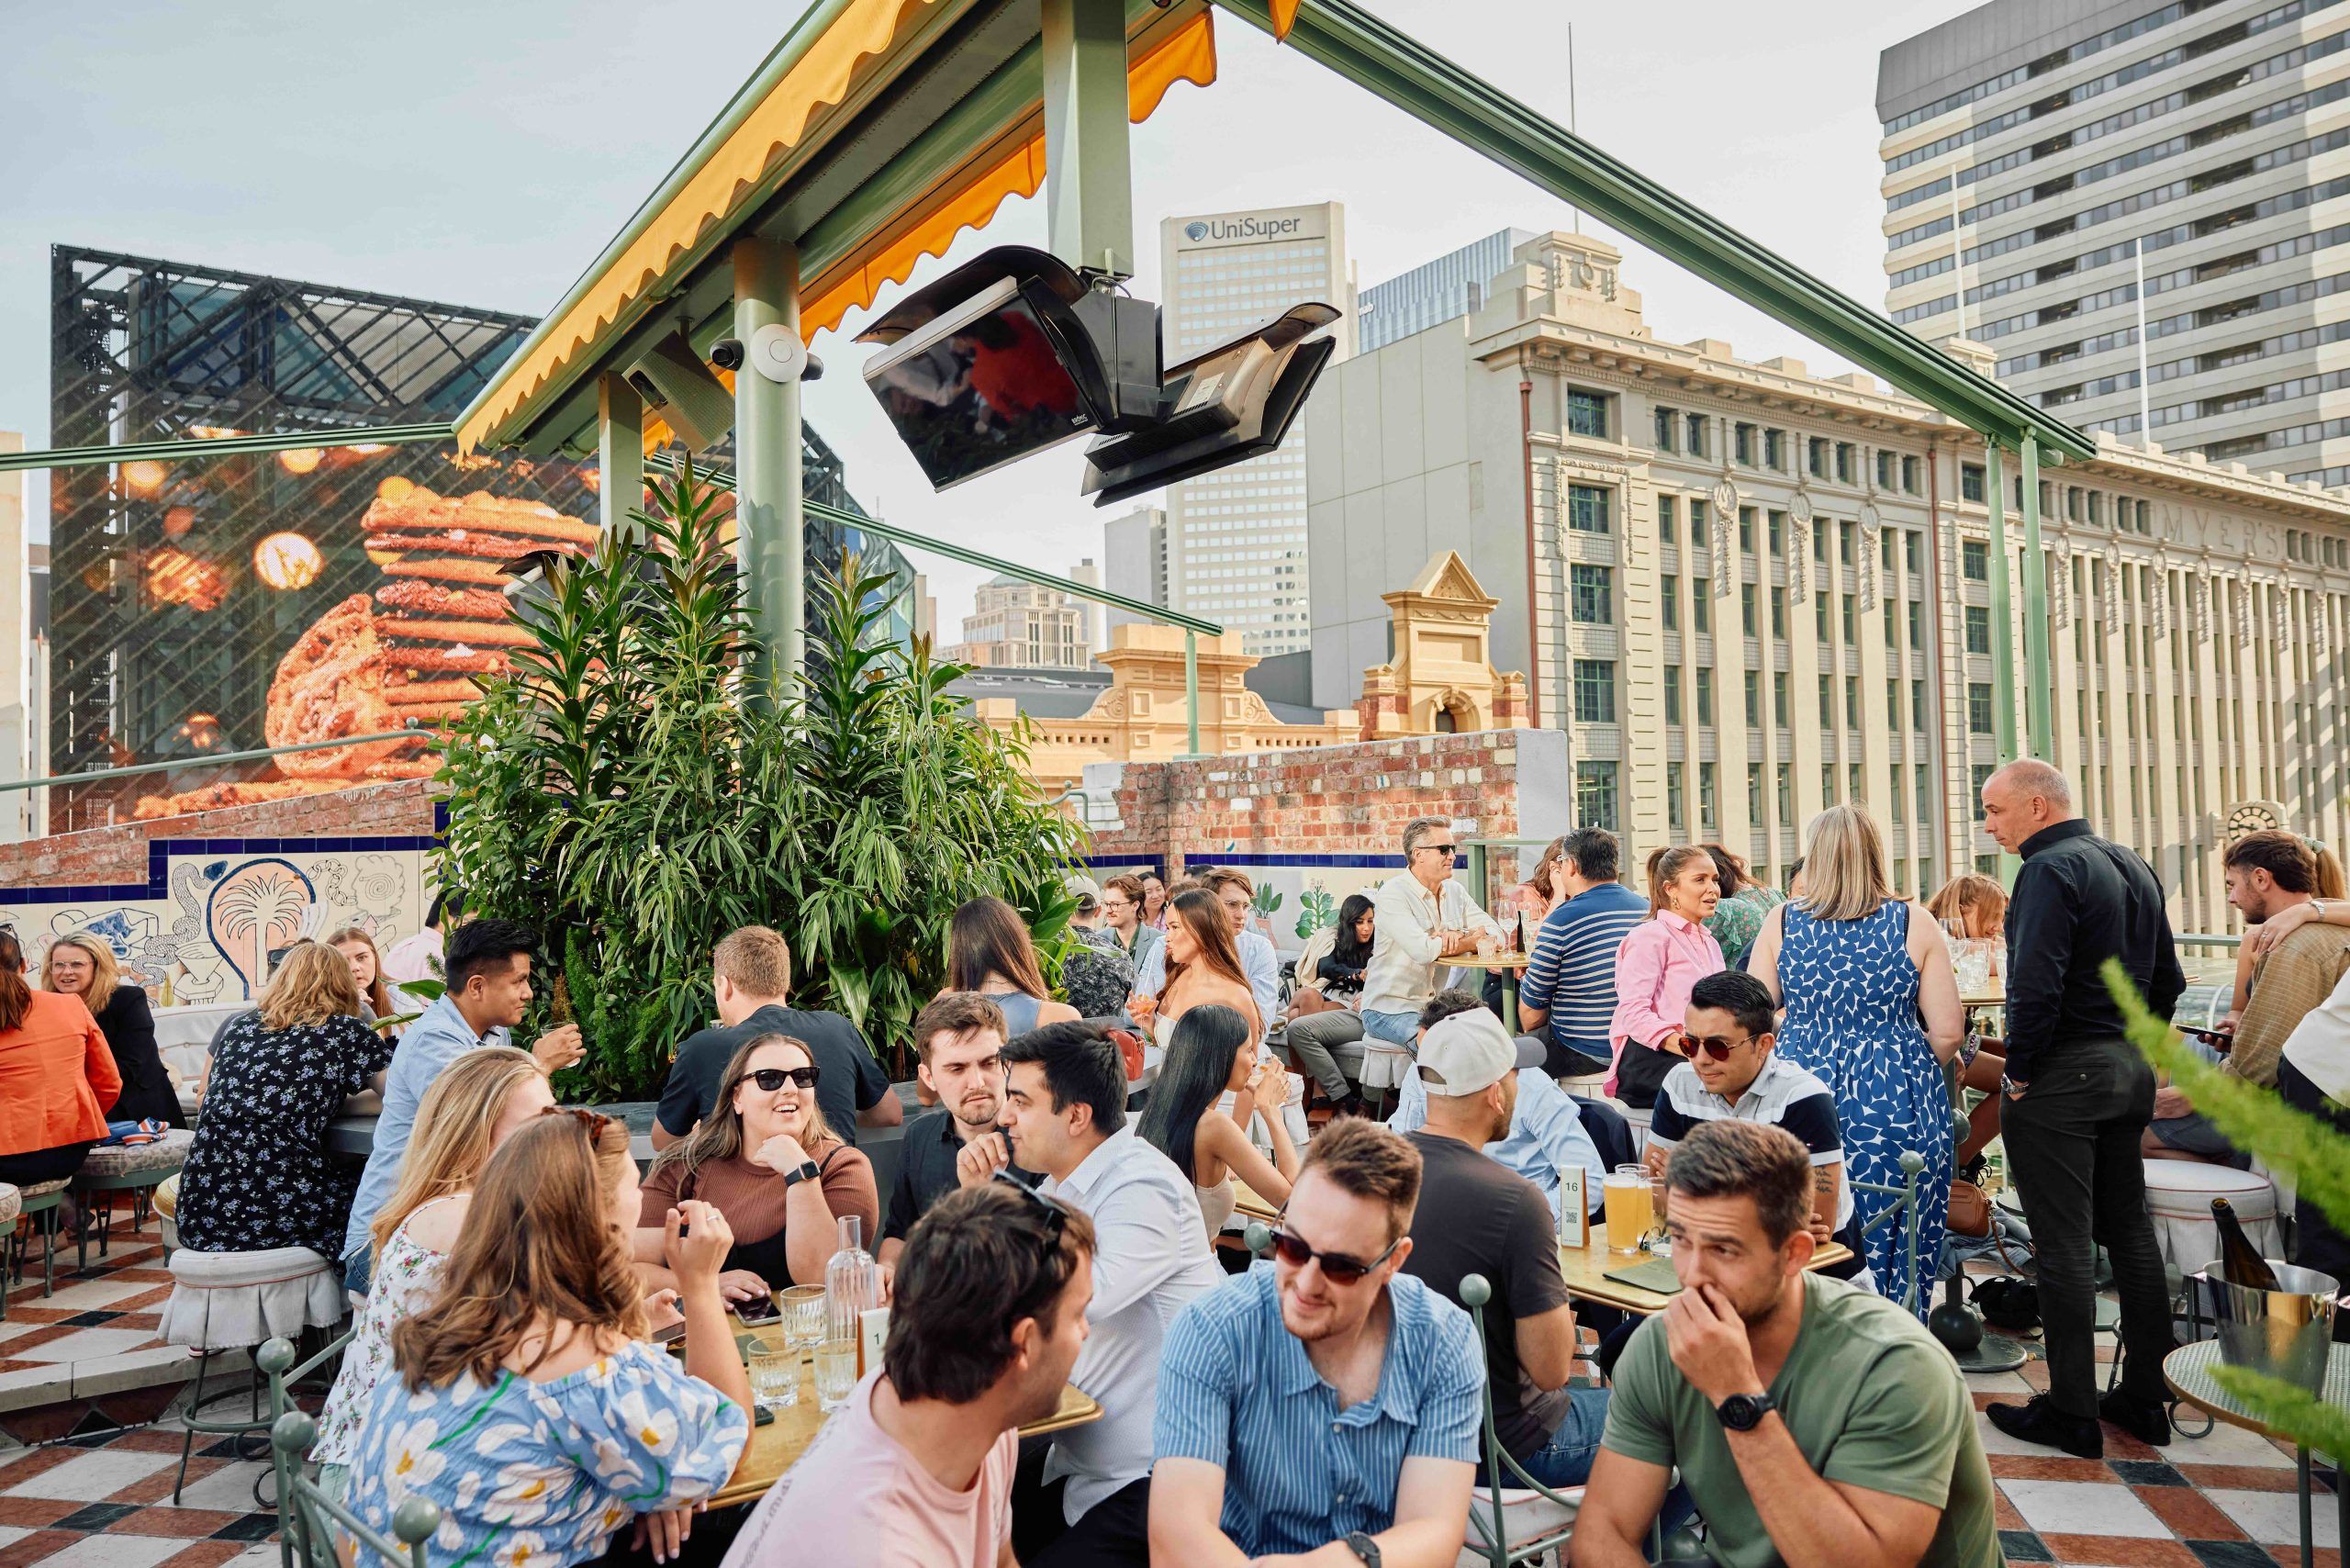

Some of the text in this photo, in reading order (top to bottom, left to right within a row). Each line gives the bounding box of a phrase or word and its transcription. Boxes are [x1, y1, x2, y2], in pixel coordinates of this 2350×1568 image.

[1211, 217, 1301, 241] UniSuper
[2162, 503, 2279, 557] MYER'S
[1565, 1182, 1579, 1193] 16
